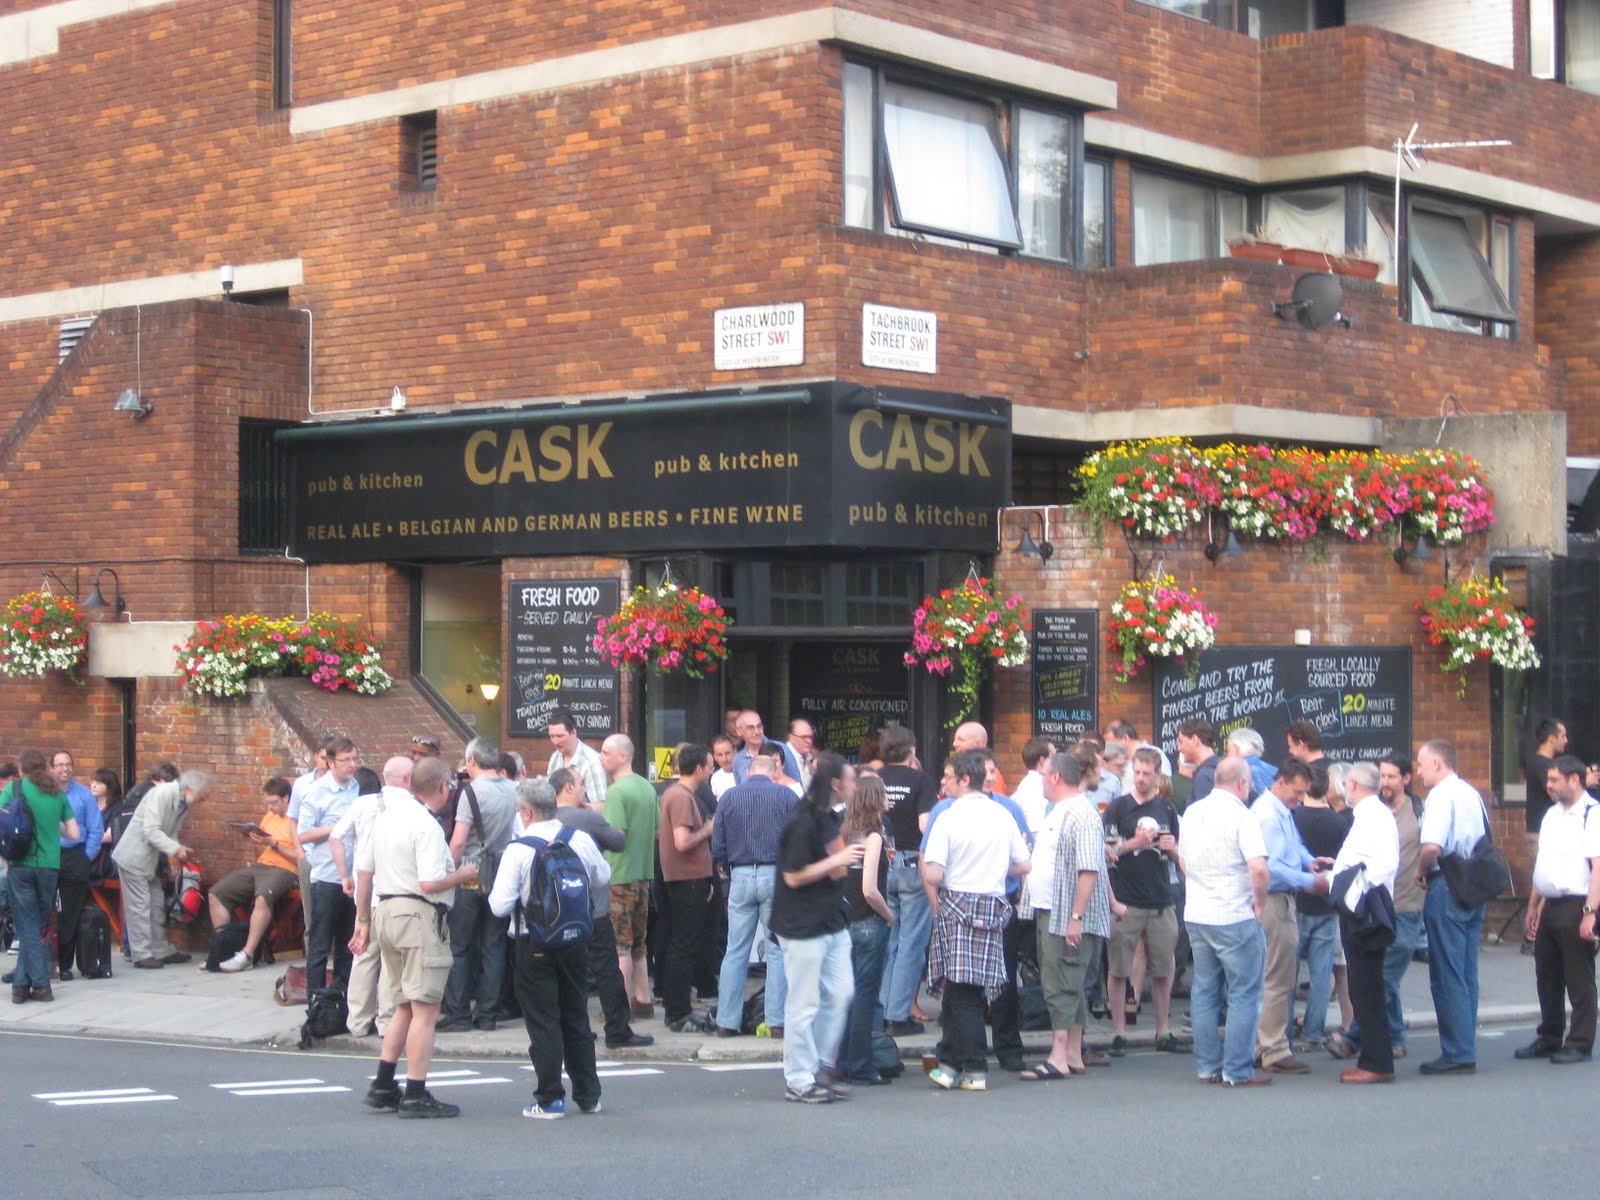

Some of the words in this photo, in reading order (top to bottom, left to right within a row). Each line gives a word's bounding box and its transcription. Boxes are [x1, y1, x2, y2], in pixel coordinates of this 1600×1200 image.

[722, 310, 795, 331] CHARLWOOD
[870, 311, 931, 334] TACHBROOK
[722, 332, 763, 350] STREET
[767, 330, 790, 346] SW1
[870, 331, 906, 349] STREET
[910, 336, 929, 352] SW1
[464, 421, 614, 485] CASK
[849, 408, 991, 477] CASK
[655, 455, 691, 479] pub
[698, 453, 712, 473] &
[719, 450, 799, 471] kitchen
[308, 476, 337, 496] pub
[343, 475, 354, 490] &
[359, 472, 424, 490] kitchen
[307, 524, 346, 541] REAL
[351, 522, 381, 539] ALE
[400, 518, 476, 537] BELGIAN
[482, 516, 519, 534] AND
[525, 512, 601, 531] GERMAN
[608, 509, 669, 529] BEERS
[690, 506, 738, 526] FINE
[746, 504, 803, 524] WINE
[849, 501, 887, 526] pub
[895, 503, 908, 524] &
[915, 503, 988, 527] kitchen
[521, 587, 561, 607] FRESH
[565, 586, 600, 606] FOOD
[523, 610, 559, 626] SERVED
[563, 610, 593, 625] DAILY
[832, 647, 880, 665] CASK
[1341, 656, 1380, 672] LOCALLY
[544, 673, 562, 691] 20
[598, 678, 614, 689] MENU
[1162, 675, 1196, 698] COME
[1199, 670, 1221, 690] AND
[1227, 664, 1248, 683] TRY
[1252, 657, 1275, 677] THE
[1308, 672, 1348, 688] SOURCED
[1351, 672, 1376, 688] FOOD
[569, 702, 602, 711] SERVED
[801, 698, 827, 712] FULLY
[831, 699, 847, 712] AIR
[849, 699, 908, 713] CONDITIONED
[1162, 694, 1202, 720] FINEST
[1205, 683, 1239, 709] BEERS
[1244, 675, 1274, 697] FROM
[1210, 703, 1231, 724] THE
[1233, 692, 1272, 718] WORLD
[1342, 692, 1366, 714] 20
[1367, 697, 1396, 712] MINUTE
[516, 697, 560, 720] TRADITIONAL
[1038, 709, 1046, 720] 10
[1050, 709, 1070, 720] REAL
[1071, 709, 1092, 721] ALES
[587, 715, 611, 729] SUNDAY
[1040, 722, 1063, 733] FRESH
[1065, 722, 1085, 733] FOOD
[1345, 714, 1368, 728] LUNCH
[1371, 714, 1394, 728] MENU
